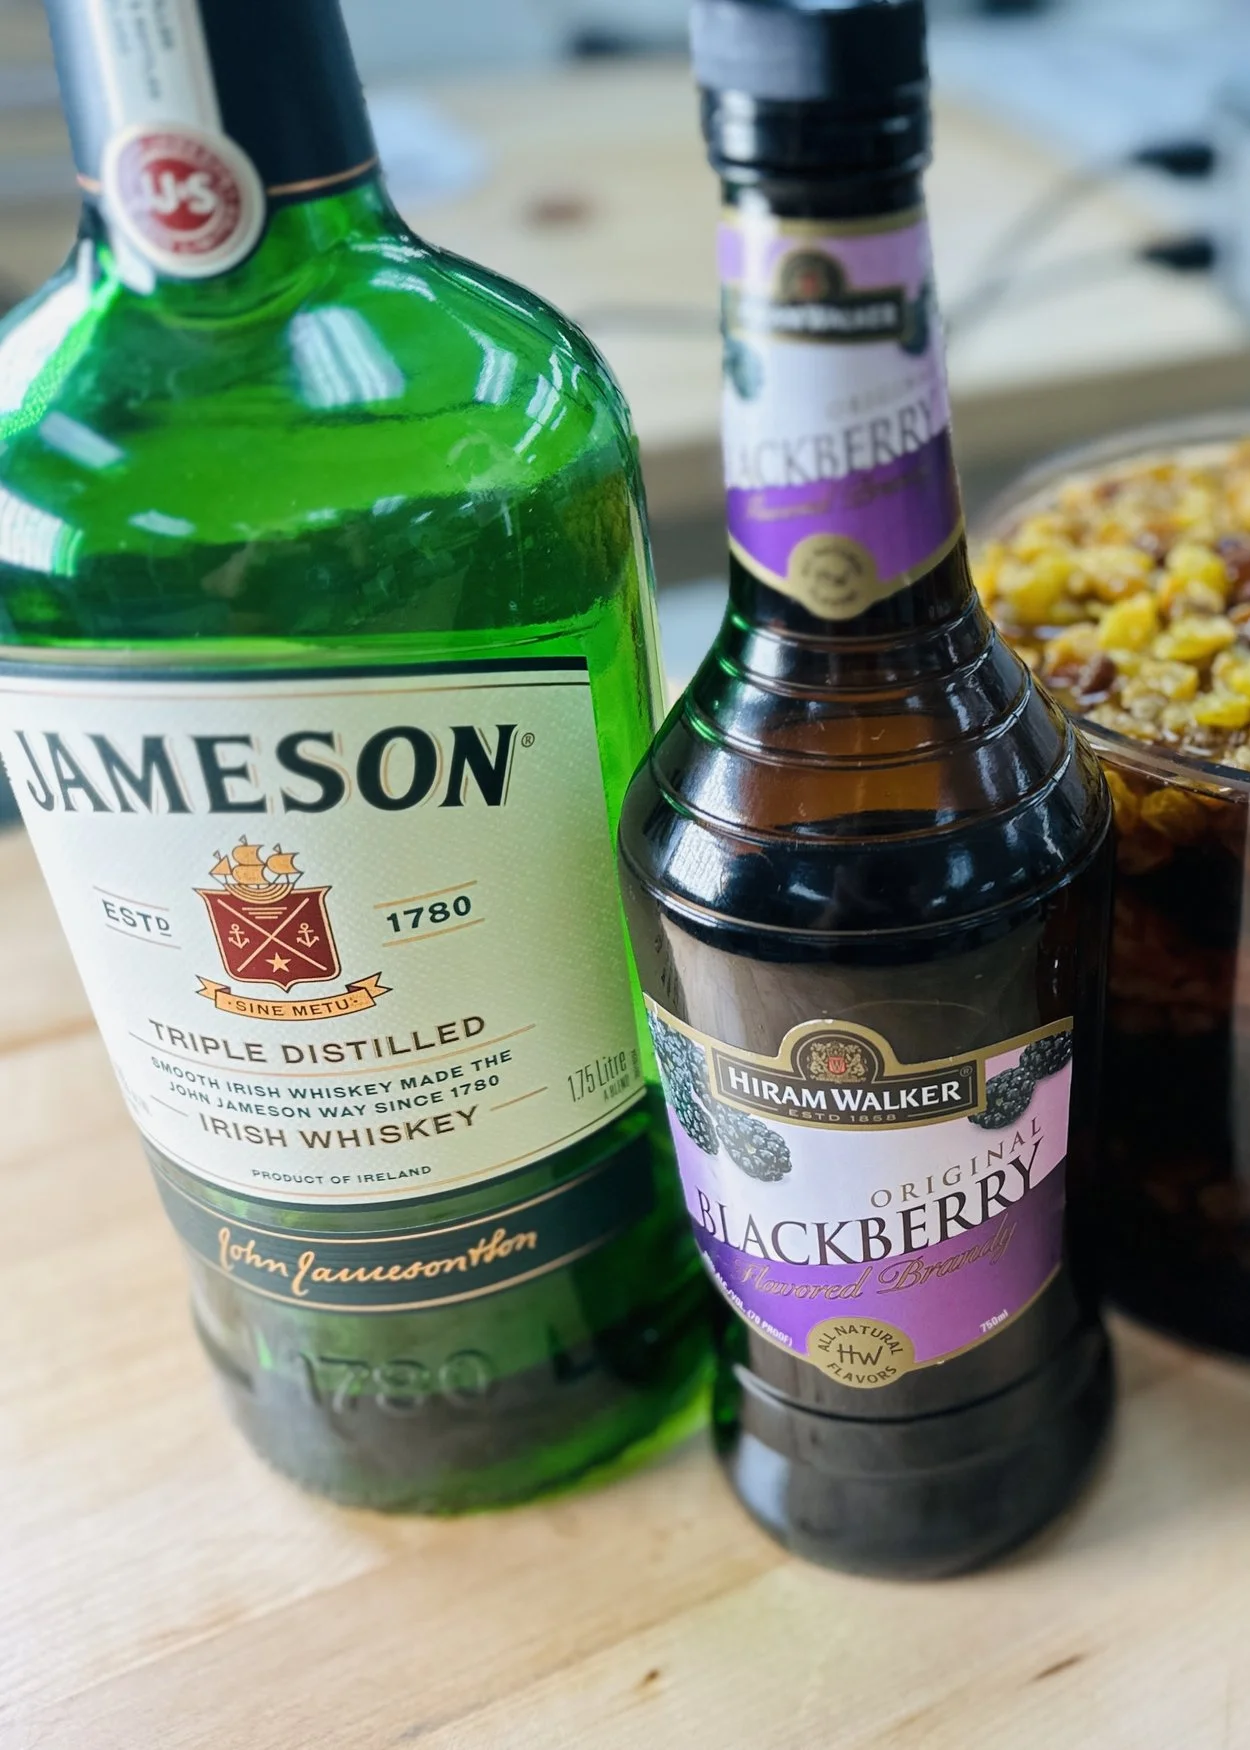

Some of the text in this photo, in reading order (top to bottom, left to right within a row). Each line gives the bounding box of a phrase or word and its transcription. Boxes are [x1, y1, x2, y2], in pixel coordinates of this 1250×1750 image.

[12, 723, 519, 815] JAMESON
[101, 897, 173, 937] ESTD
[386, 894, 473, 933] 1780
[235, 998, 350, 1018] SINE METU
[147, 1014, 487, 1065] TRIPLE DISTILLED
[151, 1055, 221, 1090] SMOOTH
[226, 1080, 282, 1098] IRISH
[287, 1081, 393, 1100] WHISKEY
[399, 1065, 465, 1091] MADE
[470, 1049, 513, 1072] THE
[595, 1051, 627, 1087] Litre
[727, 1065, 963, 1113] HIRAM WALKER
[169, 1081, 211, 1105] JOHN
[217, 1097, 316, 1119] JAMESON
[318, 1104, 367, 1119] WAY
[374, 1090, 445, 1114] SINCE
[450, 1074, 500, 1099] 1780
[787, 1108, 898, 1124] ESTD 1858
[199, 1103, 481, 1149] IRISH WHISKEY
[251, 1165, 432, 1185] PRODUCT OF IRELAND
[869, 1116, 1043, 1209] ORIGINAL
[695, 1135, 1045, 1266] BLACKBERRY
[217, 1226, 289, 1272] John
[732, 1257, 872, 1301] Flavored
[876, 1212, 1019, 1294] Brandy
[817, 1324, 904, 1356] ALL NATURAL
[979, 1309, 1010, 1333] 750ml
[826, 1361, 898, 1385] FLAVORS
[837, 1342, 884, 1367] HW
